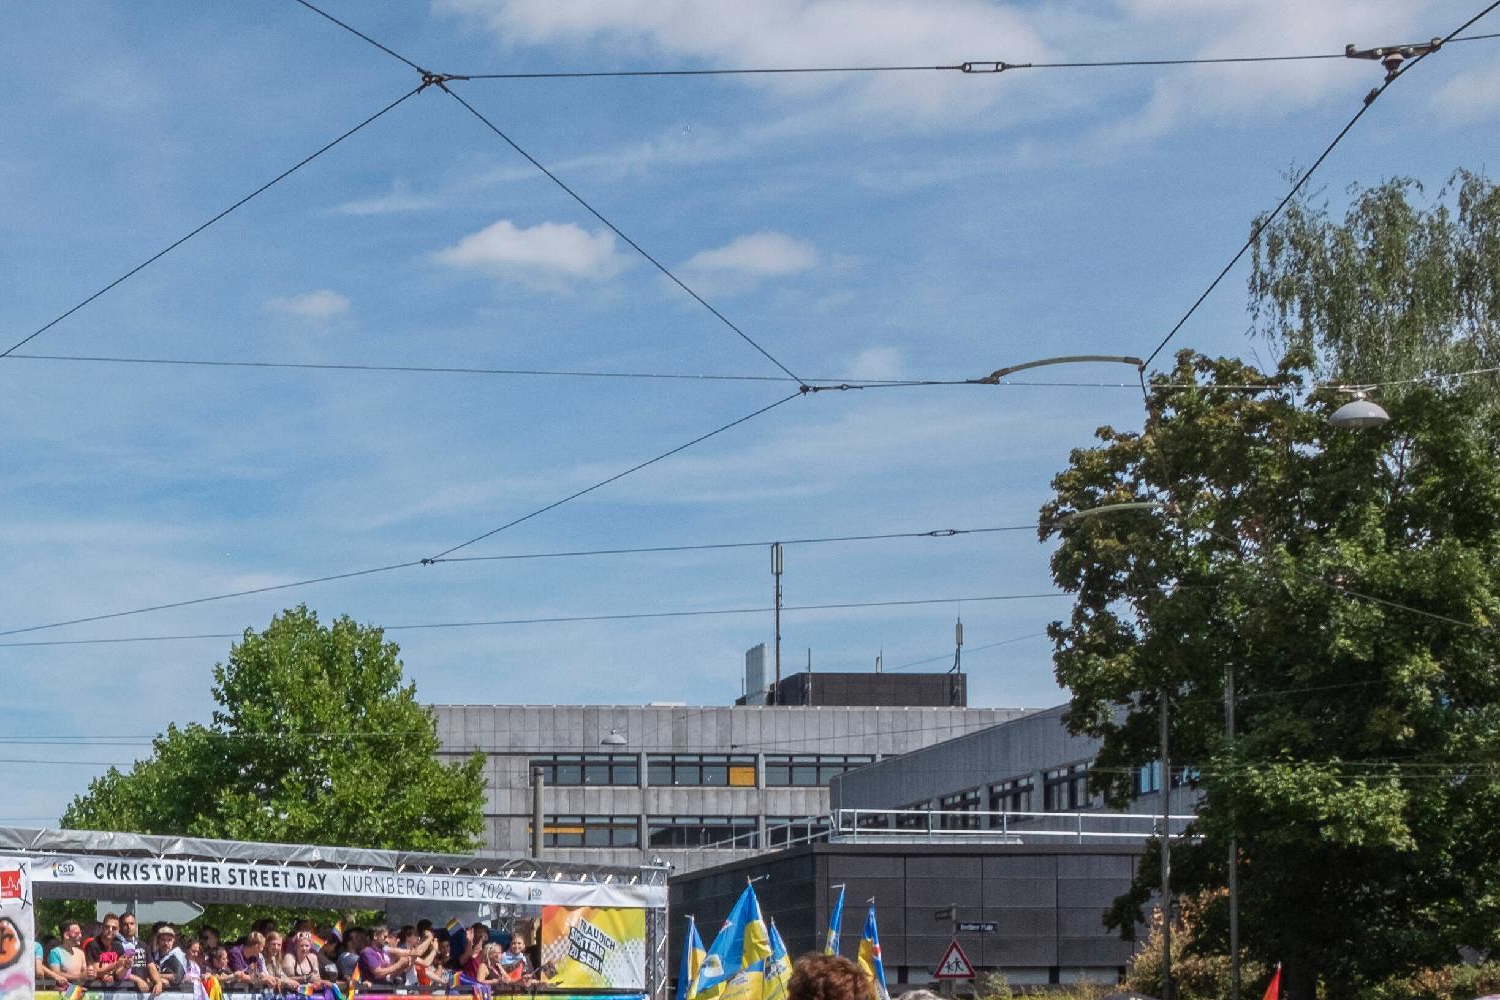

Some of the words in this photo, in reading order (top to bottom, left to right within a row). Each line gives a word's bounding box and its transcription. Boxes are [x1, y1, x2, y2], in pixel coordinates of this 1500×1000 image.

[57, 864, 74, 873] CSD
[94, 862, 221, 884] CHRISTOPHER
[228, 868, 289, 888] STREET
[297, 872, 327, 891] DAY
[432, 880, 474, 898] PRIDE
[480, 882, 513, 900] 2022
